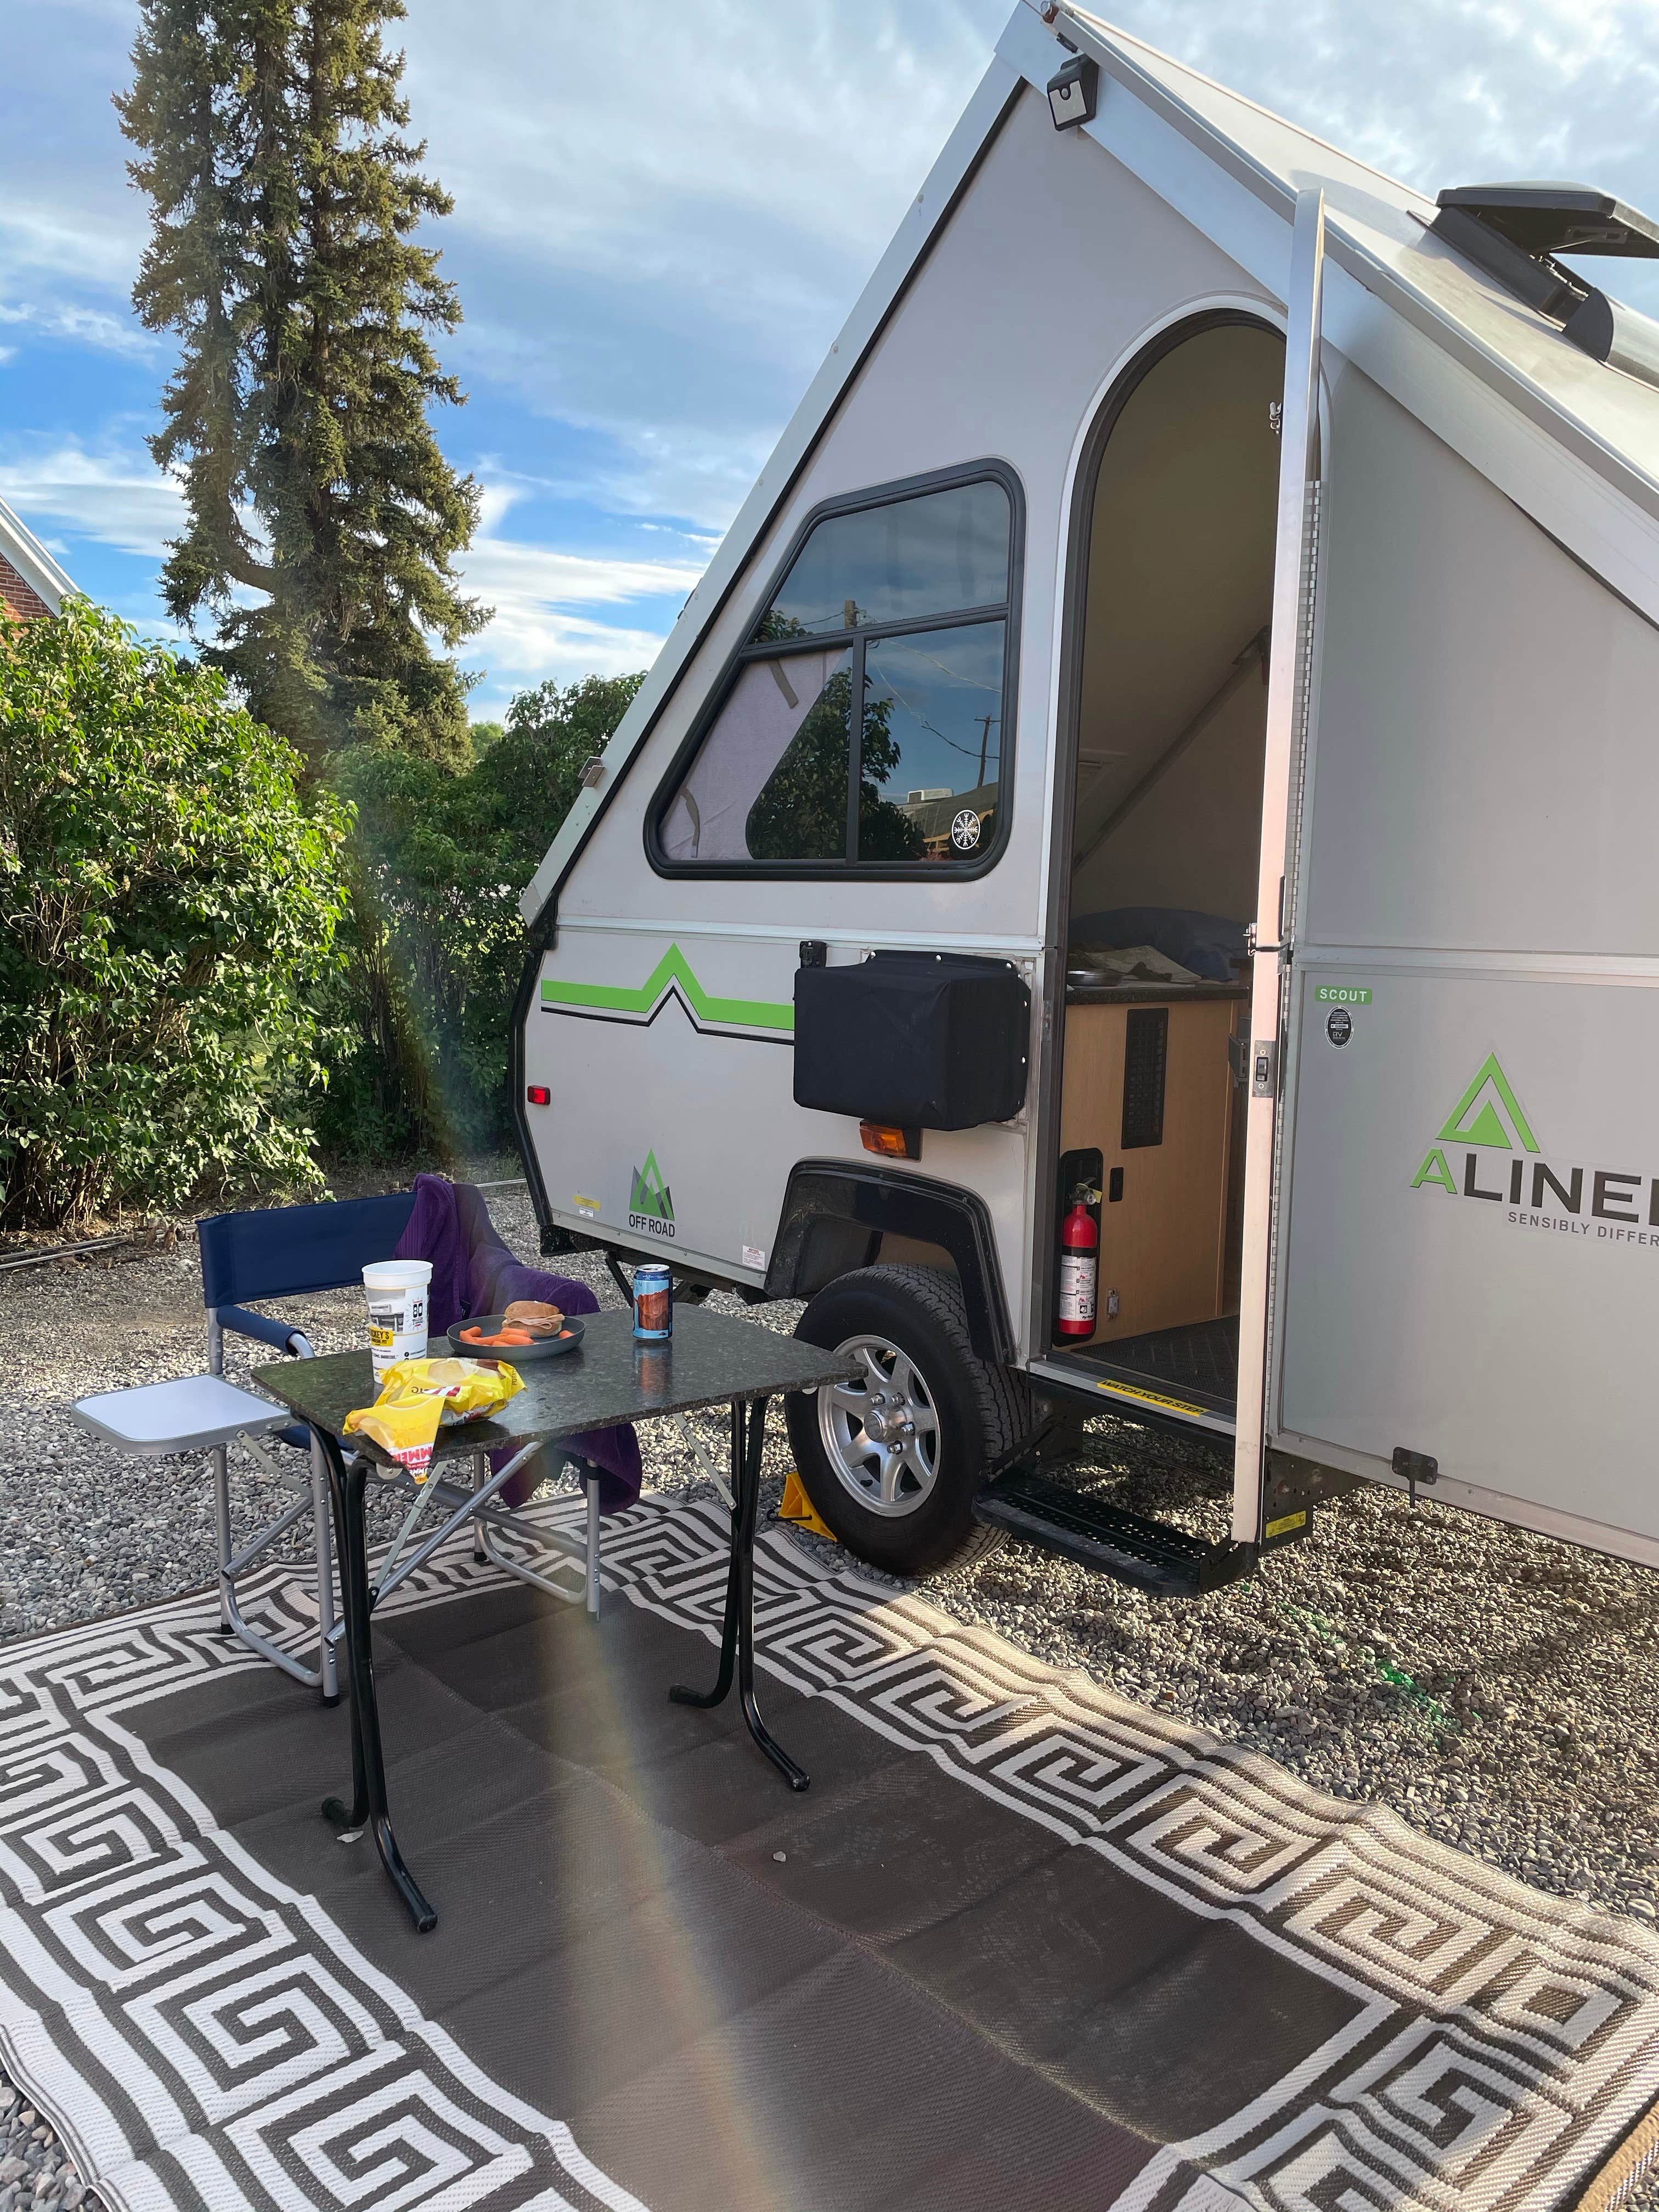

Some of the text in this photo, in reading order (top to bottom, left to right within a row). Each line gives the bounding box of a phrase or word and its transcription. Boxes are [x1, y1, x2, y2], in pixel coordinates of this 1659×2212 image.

[1319, 988, 1367, 1002] SCOUT
[1409, 1147, 1659, 1227] ALINE
[629, 1214, 675, 1237] OFF ROAD
[1508, 1211, 1659, 1248] SENSIBLY DIFFER
[413, 1302, 423, 1318] 80
[1102, 1380, 1204, 1413] WATCH YOUR STEP
